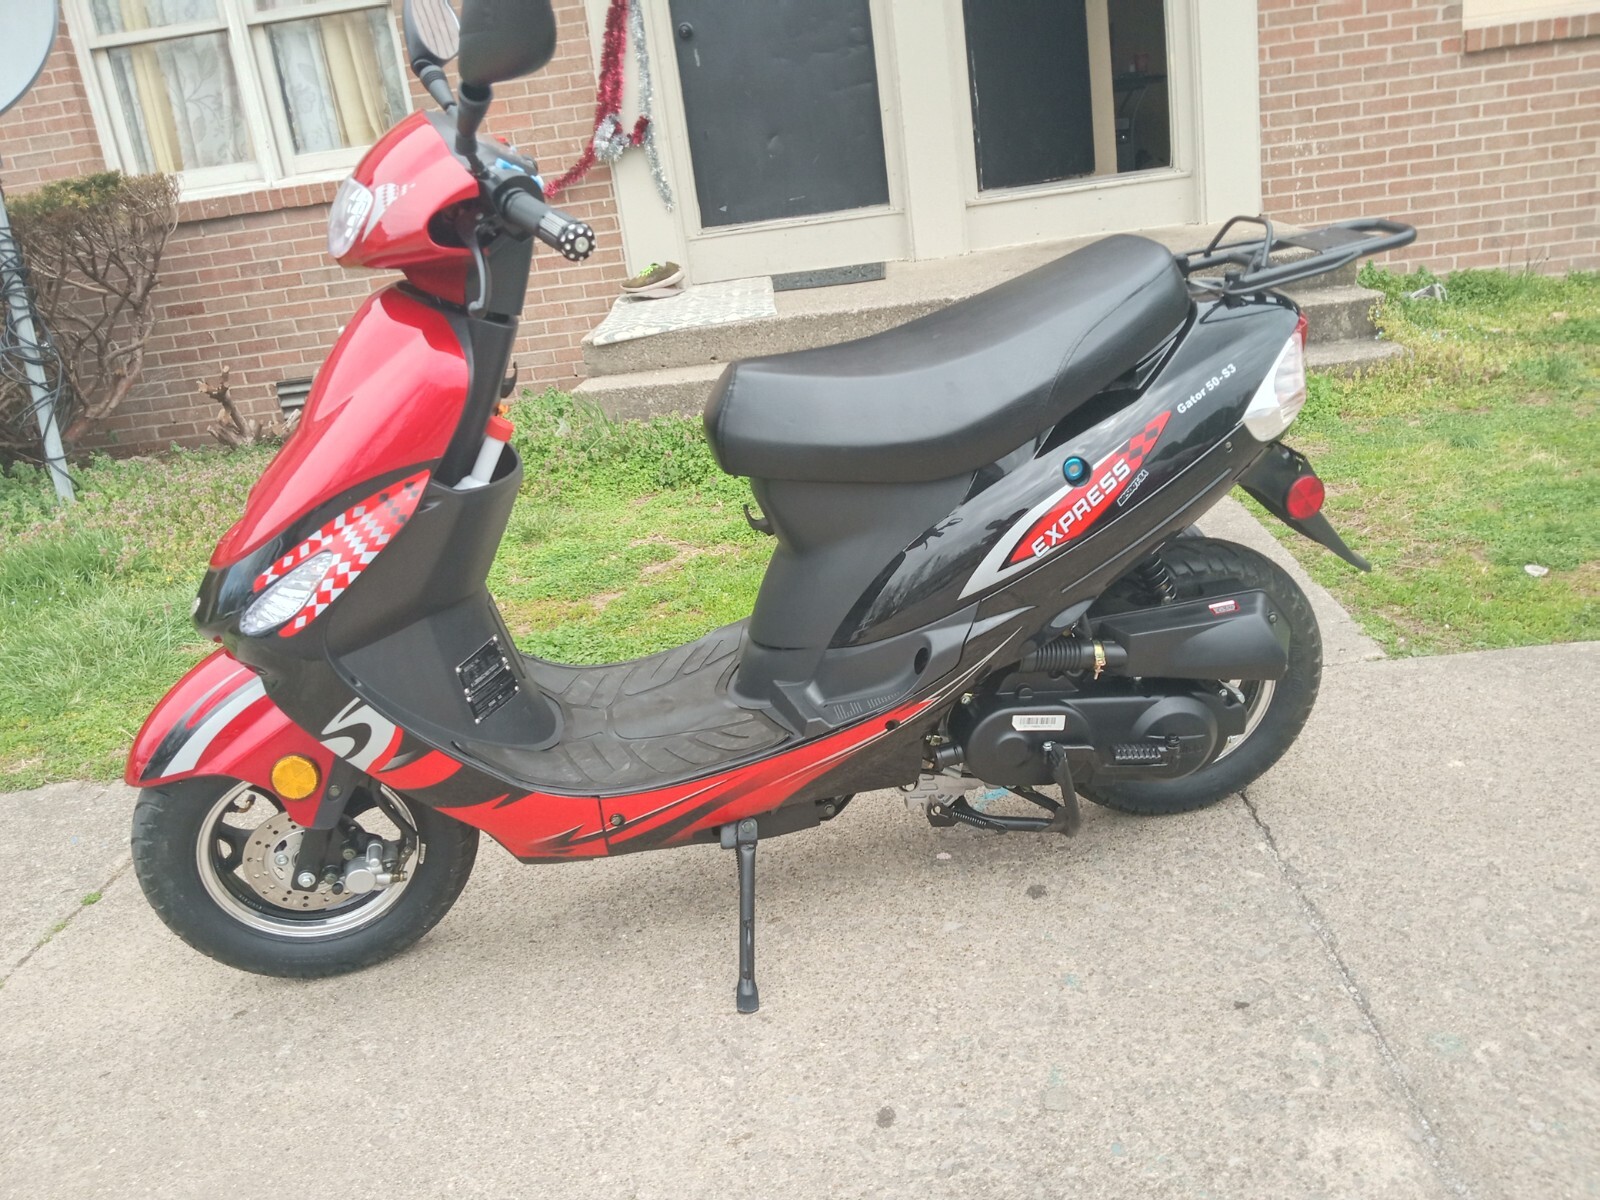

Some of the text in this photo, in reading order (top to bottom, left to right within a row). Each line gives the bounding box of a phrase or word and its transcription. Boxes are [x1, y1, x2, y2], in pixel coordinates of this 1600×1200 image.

[1177, 363, 1237, 414] Gator 50-S3
[1031, 458, 1131, 557] EXPRESS
